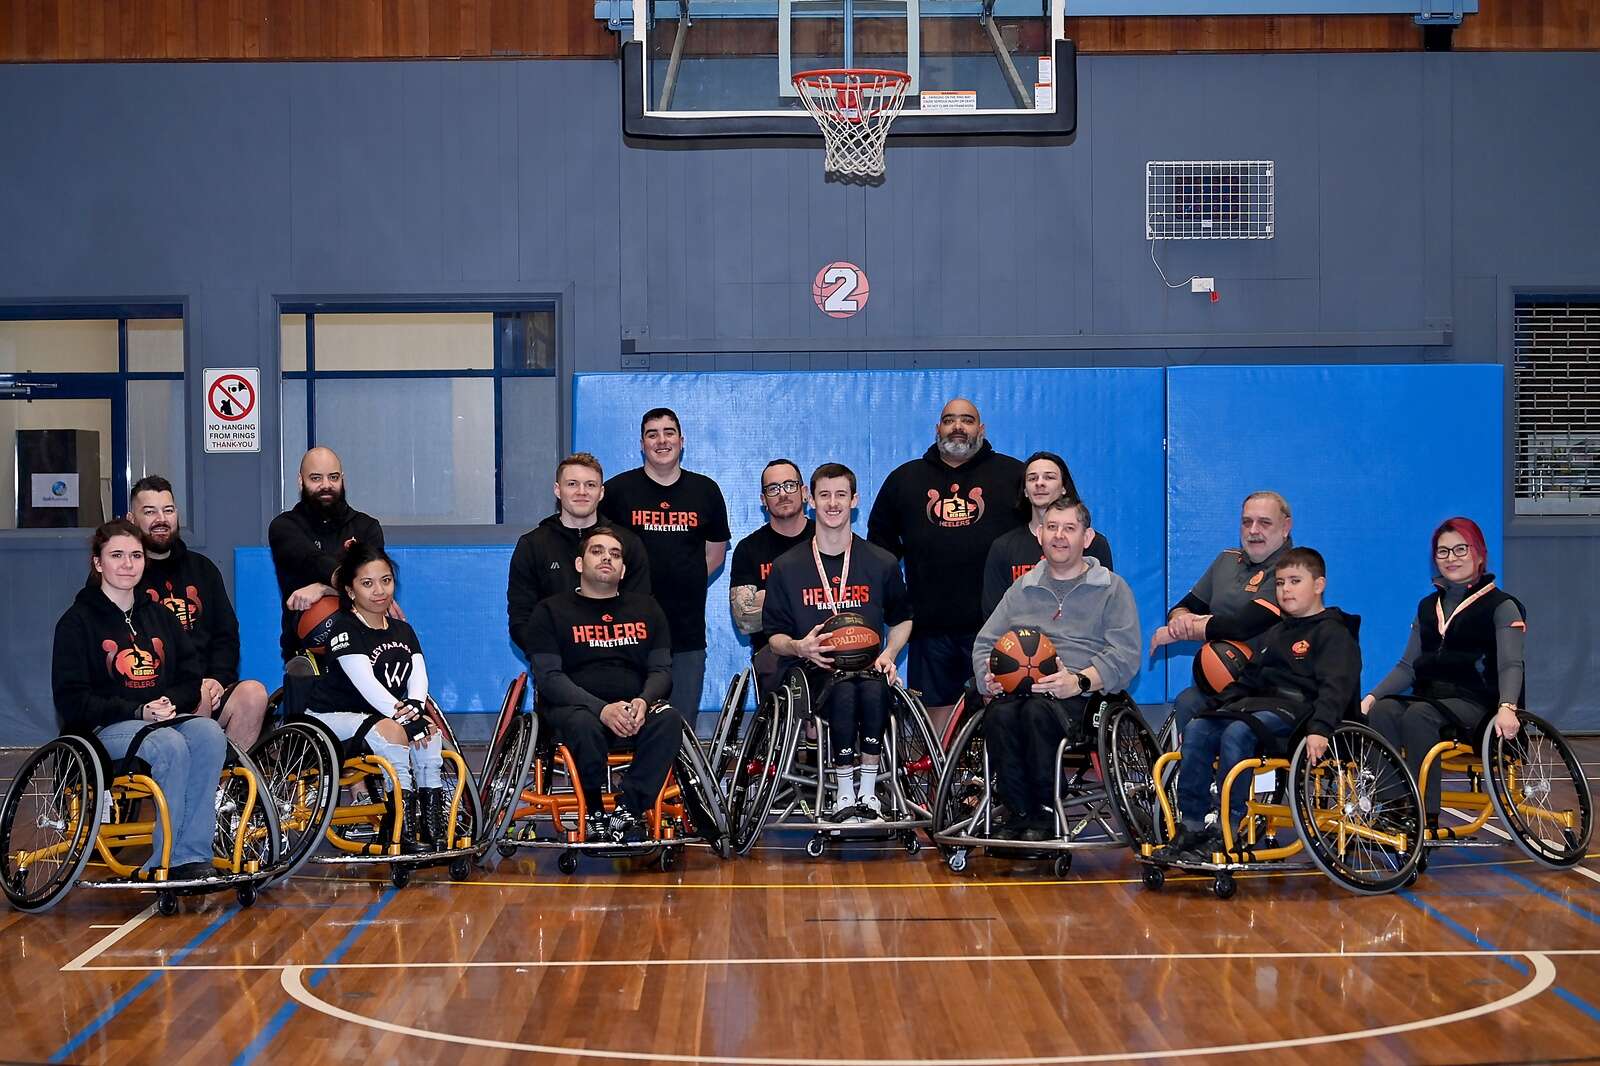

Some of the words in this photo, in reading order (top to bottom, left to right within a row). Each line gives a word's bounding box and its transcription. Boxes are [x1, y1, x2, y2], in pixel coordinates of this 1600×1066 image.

[824, 267, 858, 312] 2
[631, 510, 698, 527] HEELERS
[939, 519, 971, 527] HEELERS
[644, 523, 689, 532] BASKETBALL
[572, 622, 647, 643] HEELERS
[589, 636, 639, 648] BASKETBALL
[125, 680, 156, 689] HEELERS
